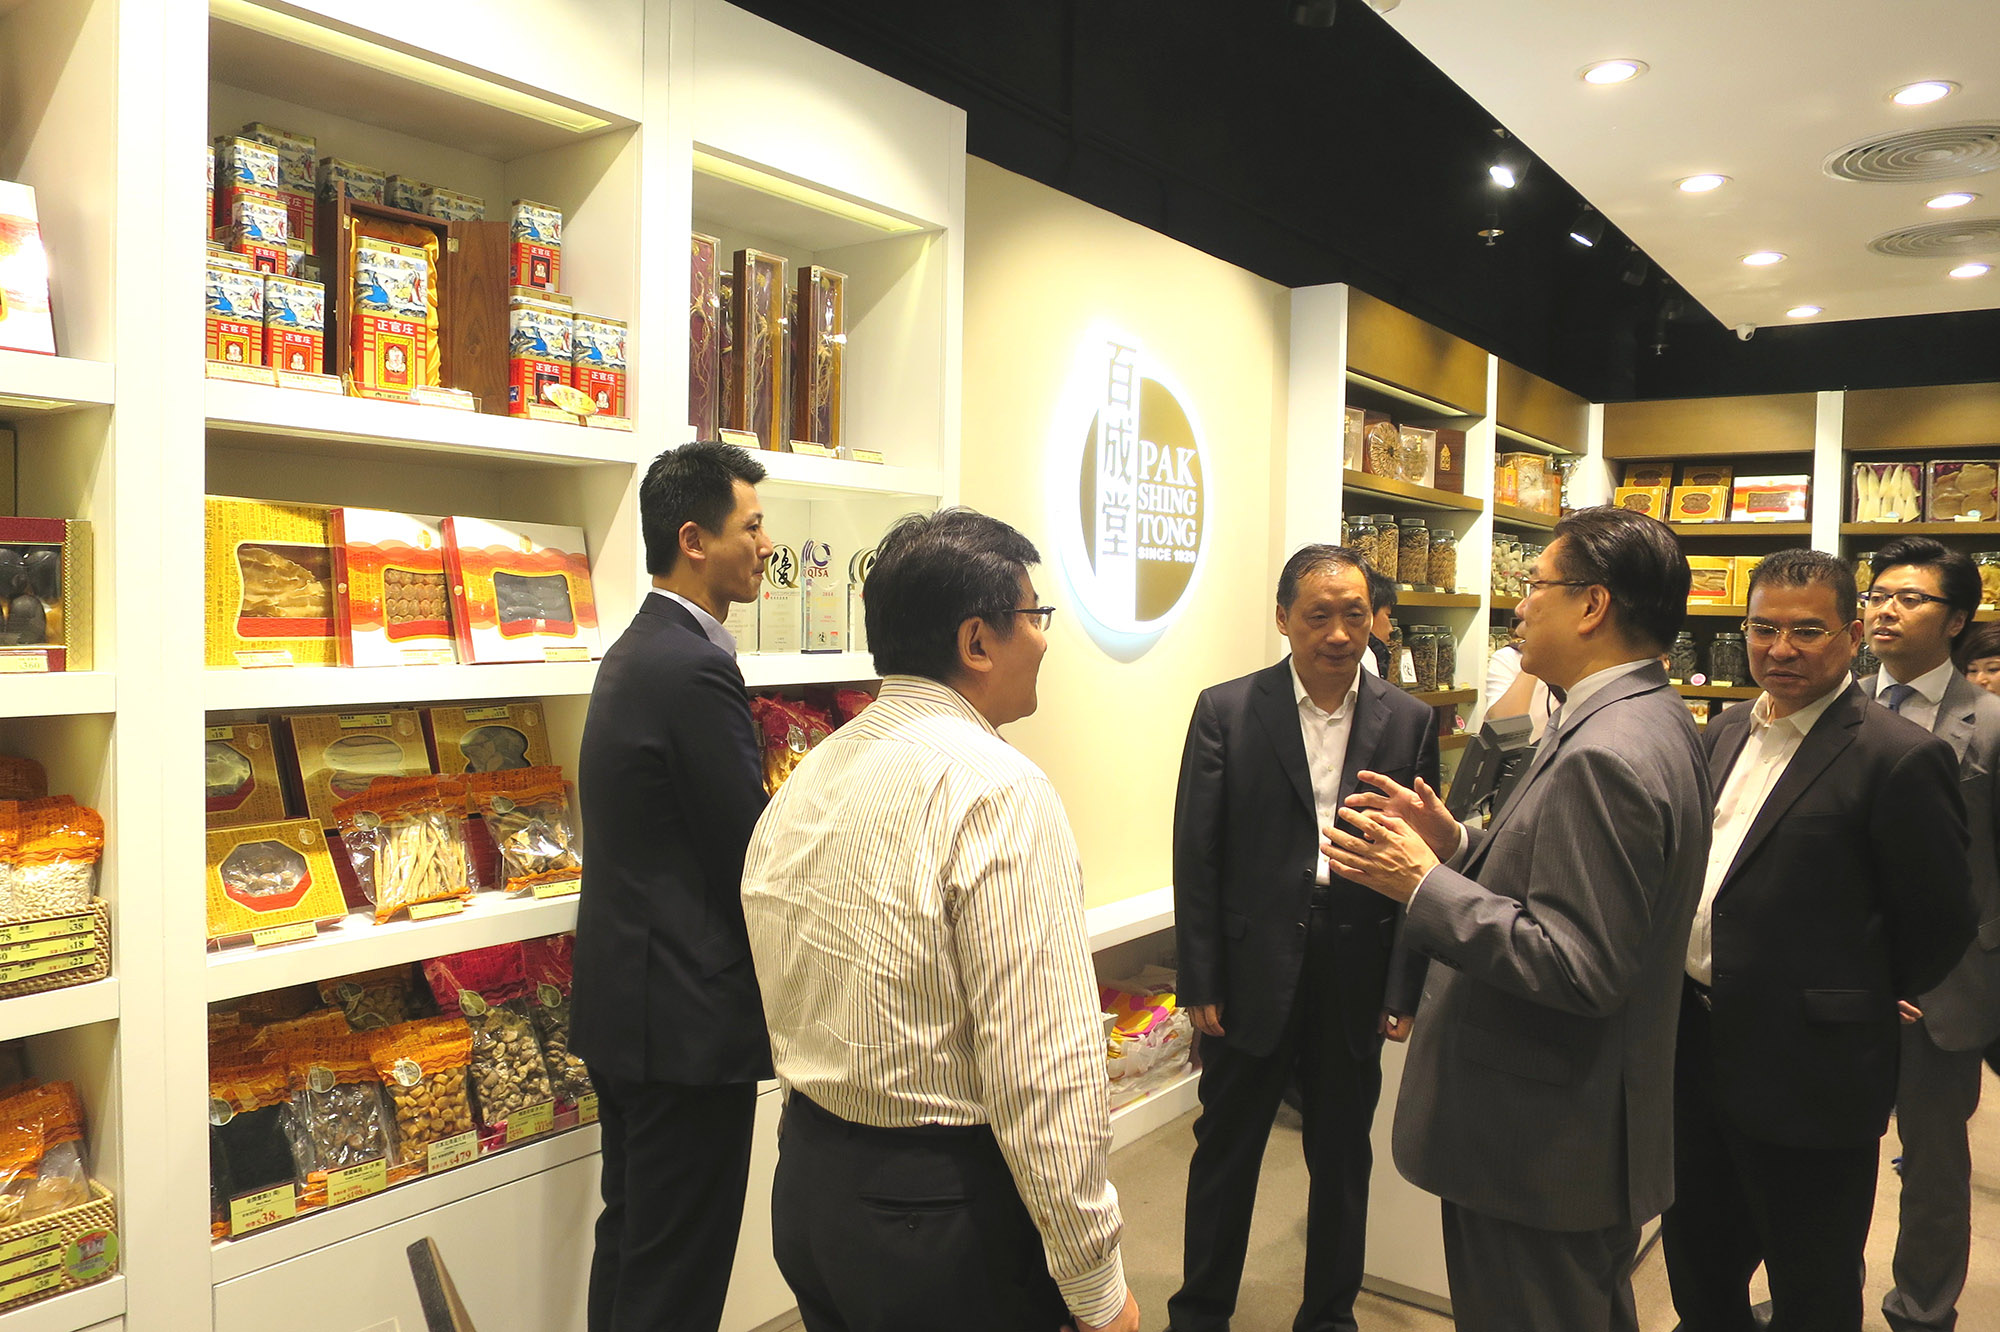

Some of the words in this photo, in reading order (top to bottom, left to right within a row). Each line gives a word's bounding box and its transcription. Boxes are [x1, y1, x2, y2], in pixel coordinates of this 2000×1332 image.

[220, 322, 249, 335] 正官庄
[377, 319, 415, 335] 正官庄
[285, 332, 312, 344] 正官庄
[535, 362, 560, 374] 正官庄
[591, 370, 615, 383] 正官庄
[1102, 341, 1137, 557] 百成堂
[1138, 440, 1198, 487] PAK
[1138, 482, 1198, 516] SHING
[1138, 512, 1197, 548] TONG
[1137, 546, 1172, 562] SINCE
[807, 566, 829, 578] QTSA
[69, 922, 84, 932] $38
[70, 940, 84, 950] $18
[70, 957, 84, 966] $22
[449, 1150, 472, 1166] $479
